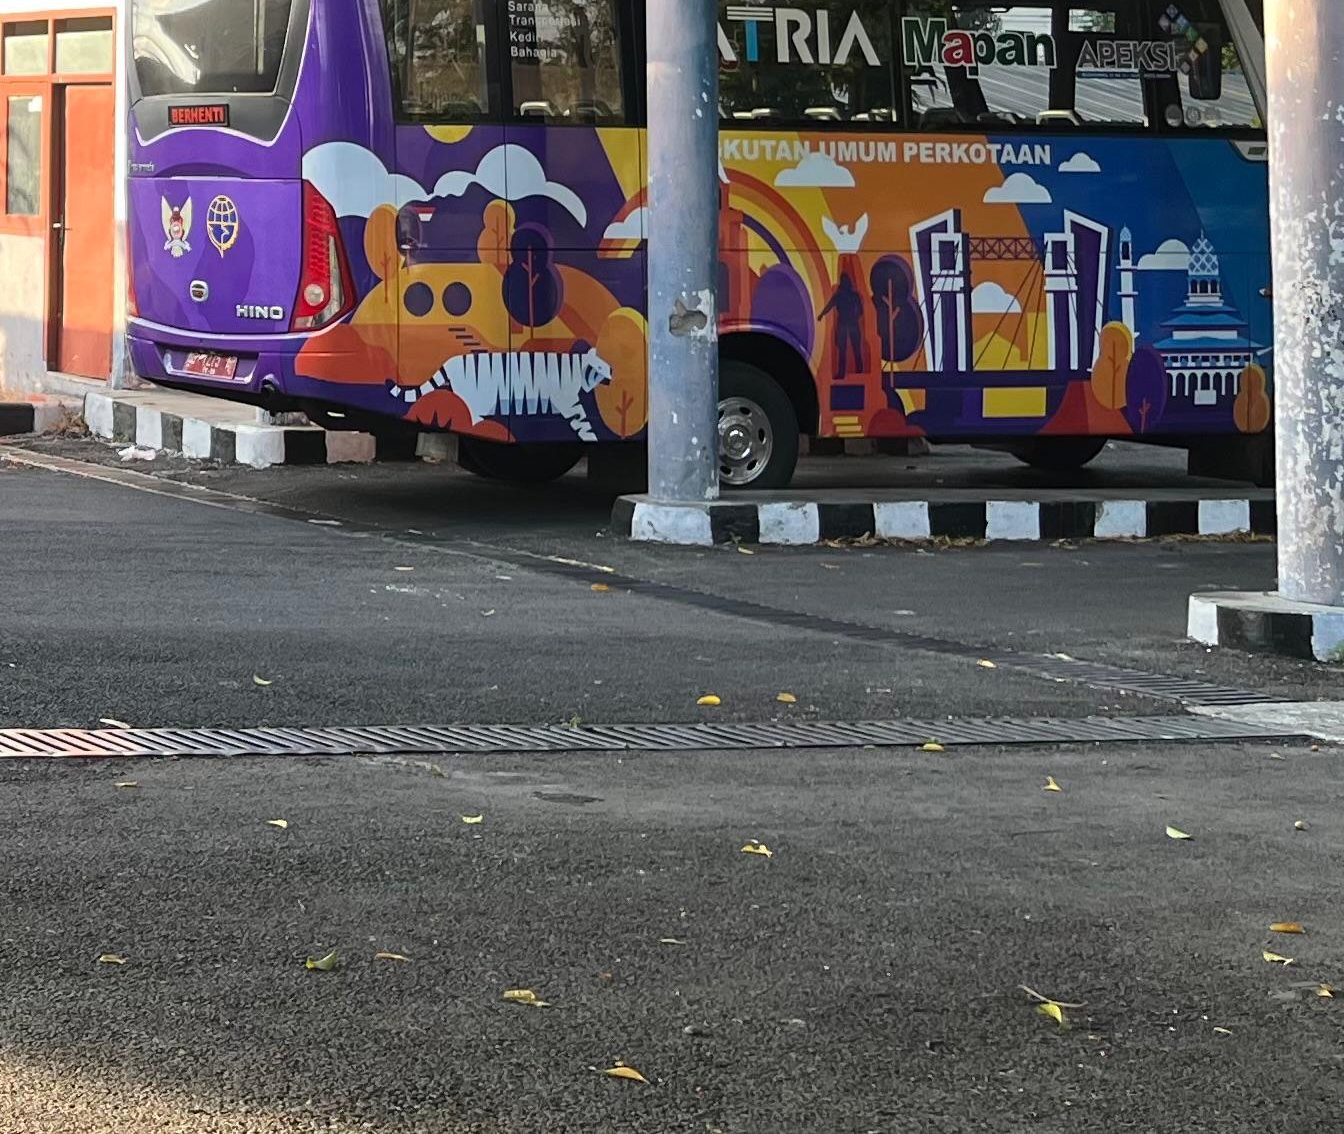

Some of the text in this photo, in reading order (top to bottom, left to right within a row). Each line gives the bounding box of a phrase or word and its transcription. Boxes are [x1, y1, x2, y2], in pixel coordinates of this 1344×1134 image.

[717, 6, 1177, 79] TRIA Mapan APEKSI
[171, 106, 224, 124] BERHENTI
[719, 138, 1051, 165] KUTAN UMUM PERKOTAAN
[235, 304, 285, 320] HINO
